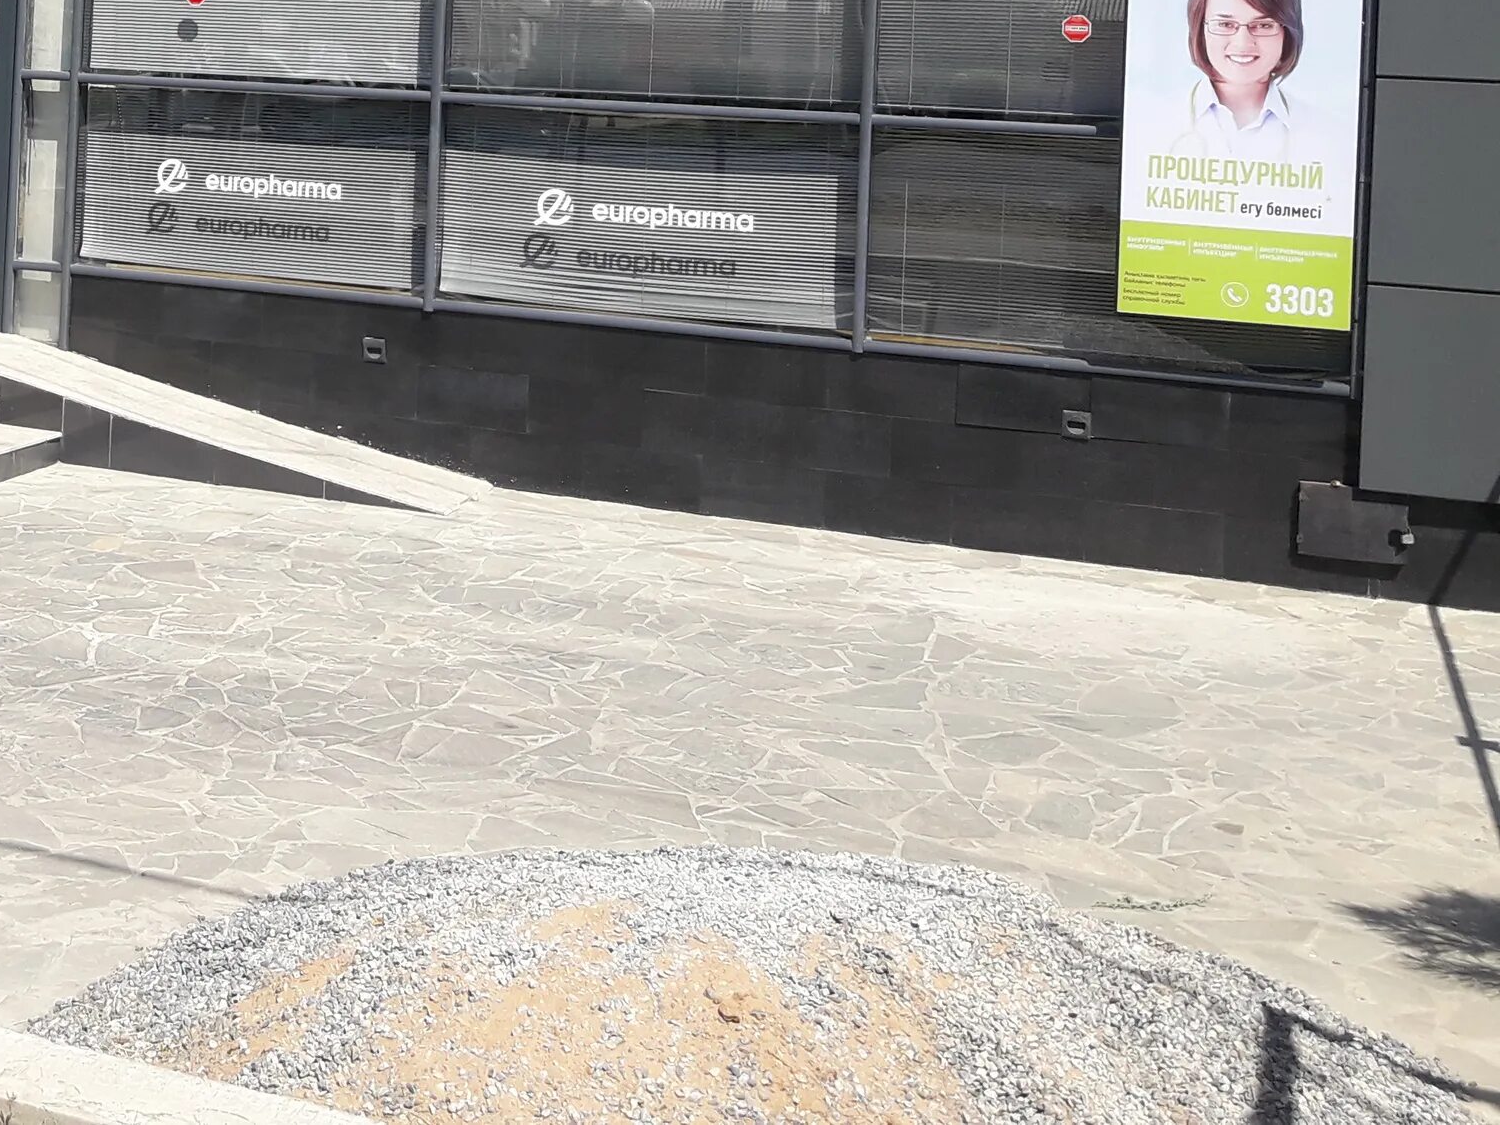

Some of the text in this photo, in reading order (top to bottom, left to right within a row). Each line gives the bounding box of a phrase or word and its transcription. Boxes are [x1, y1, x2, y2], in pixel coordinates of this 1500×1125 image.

[205, 173, 342, 201] europharma
[1148, 154, 1323, 190] ПРОЦЕДУРНЫЙ
[1146, 186, 1239, 214] КАБИНЕТ
[1240, 202, 1322, 219] егу бөлмесі
[592, 200, 755, 233] europharma
[1265, 283, 1334, 317] 3303
